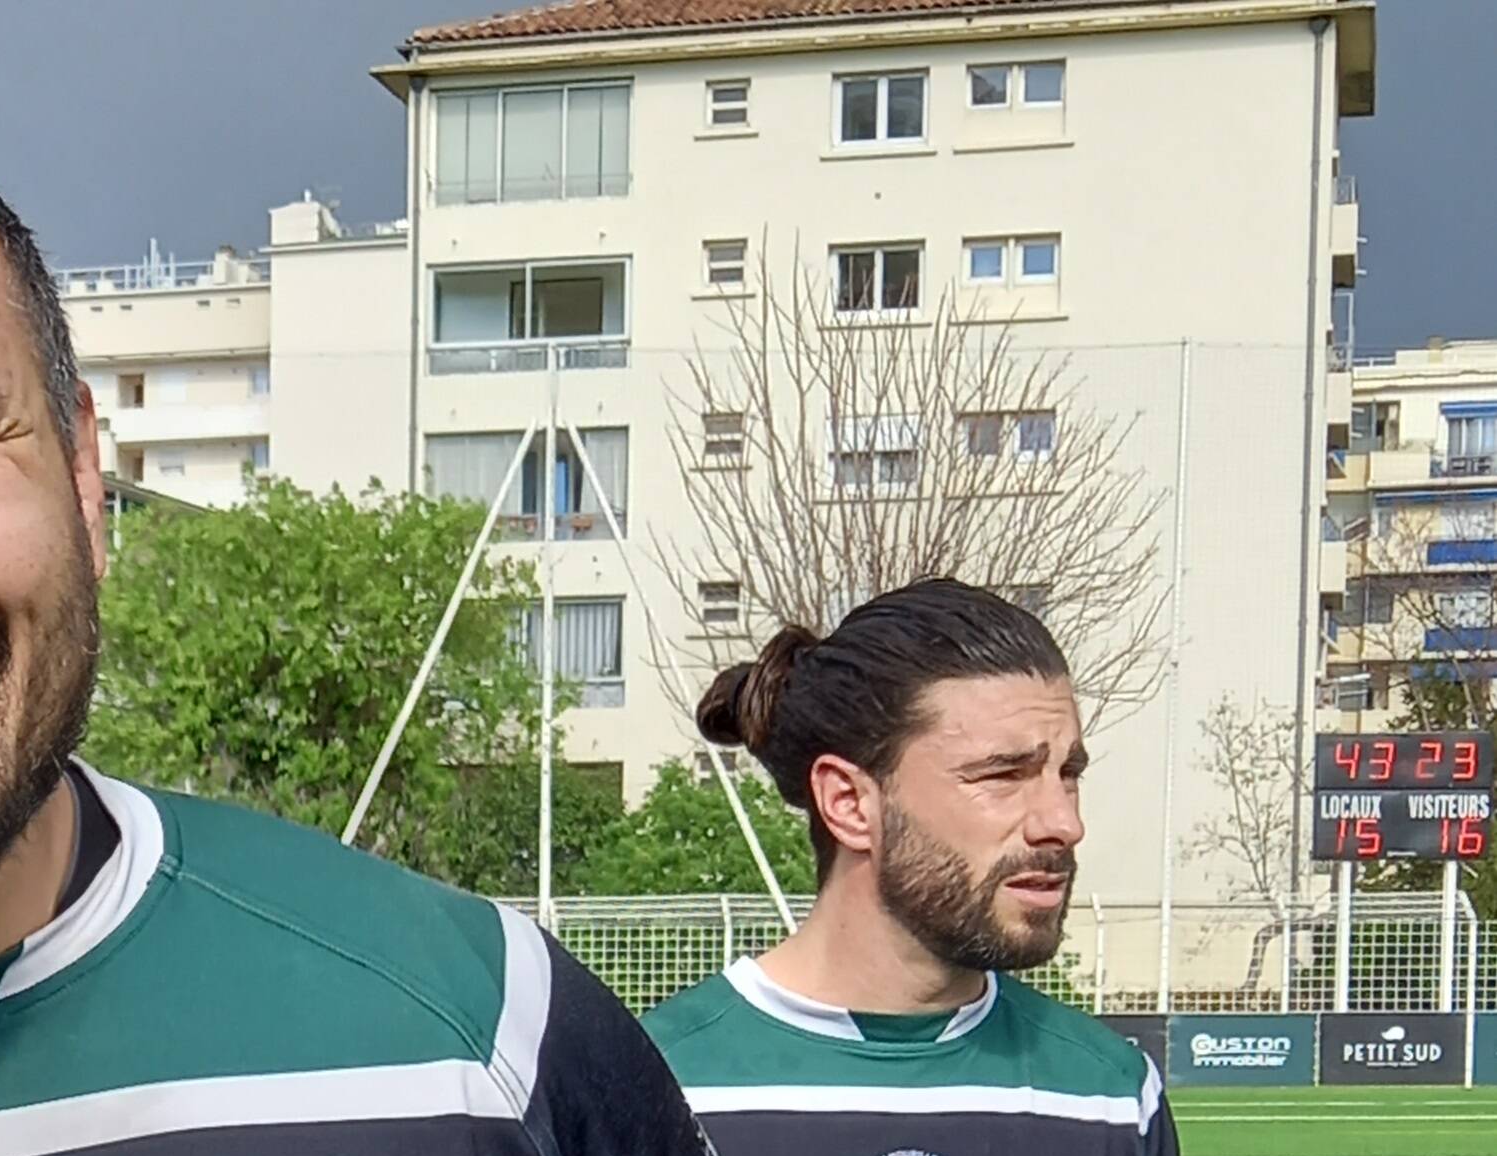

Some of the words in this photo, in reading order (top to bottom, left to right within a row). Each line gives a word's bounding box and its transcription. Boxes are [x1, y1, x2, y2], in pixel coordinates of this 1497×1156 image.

[1321, 795, 1382, 819] LOCAUX
[1408, 794, 1490, 819] VISITEURS
[1337, 819, 1382, 855] 15
[1441, 817, 1484, 855] 16
[1343, 1043, 1397, 1061] PETIT
[1403, 1043, 1442, 1062] SUD
